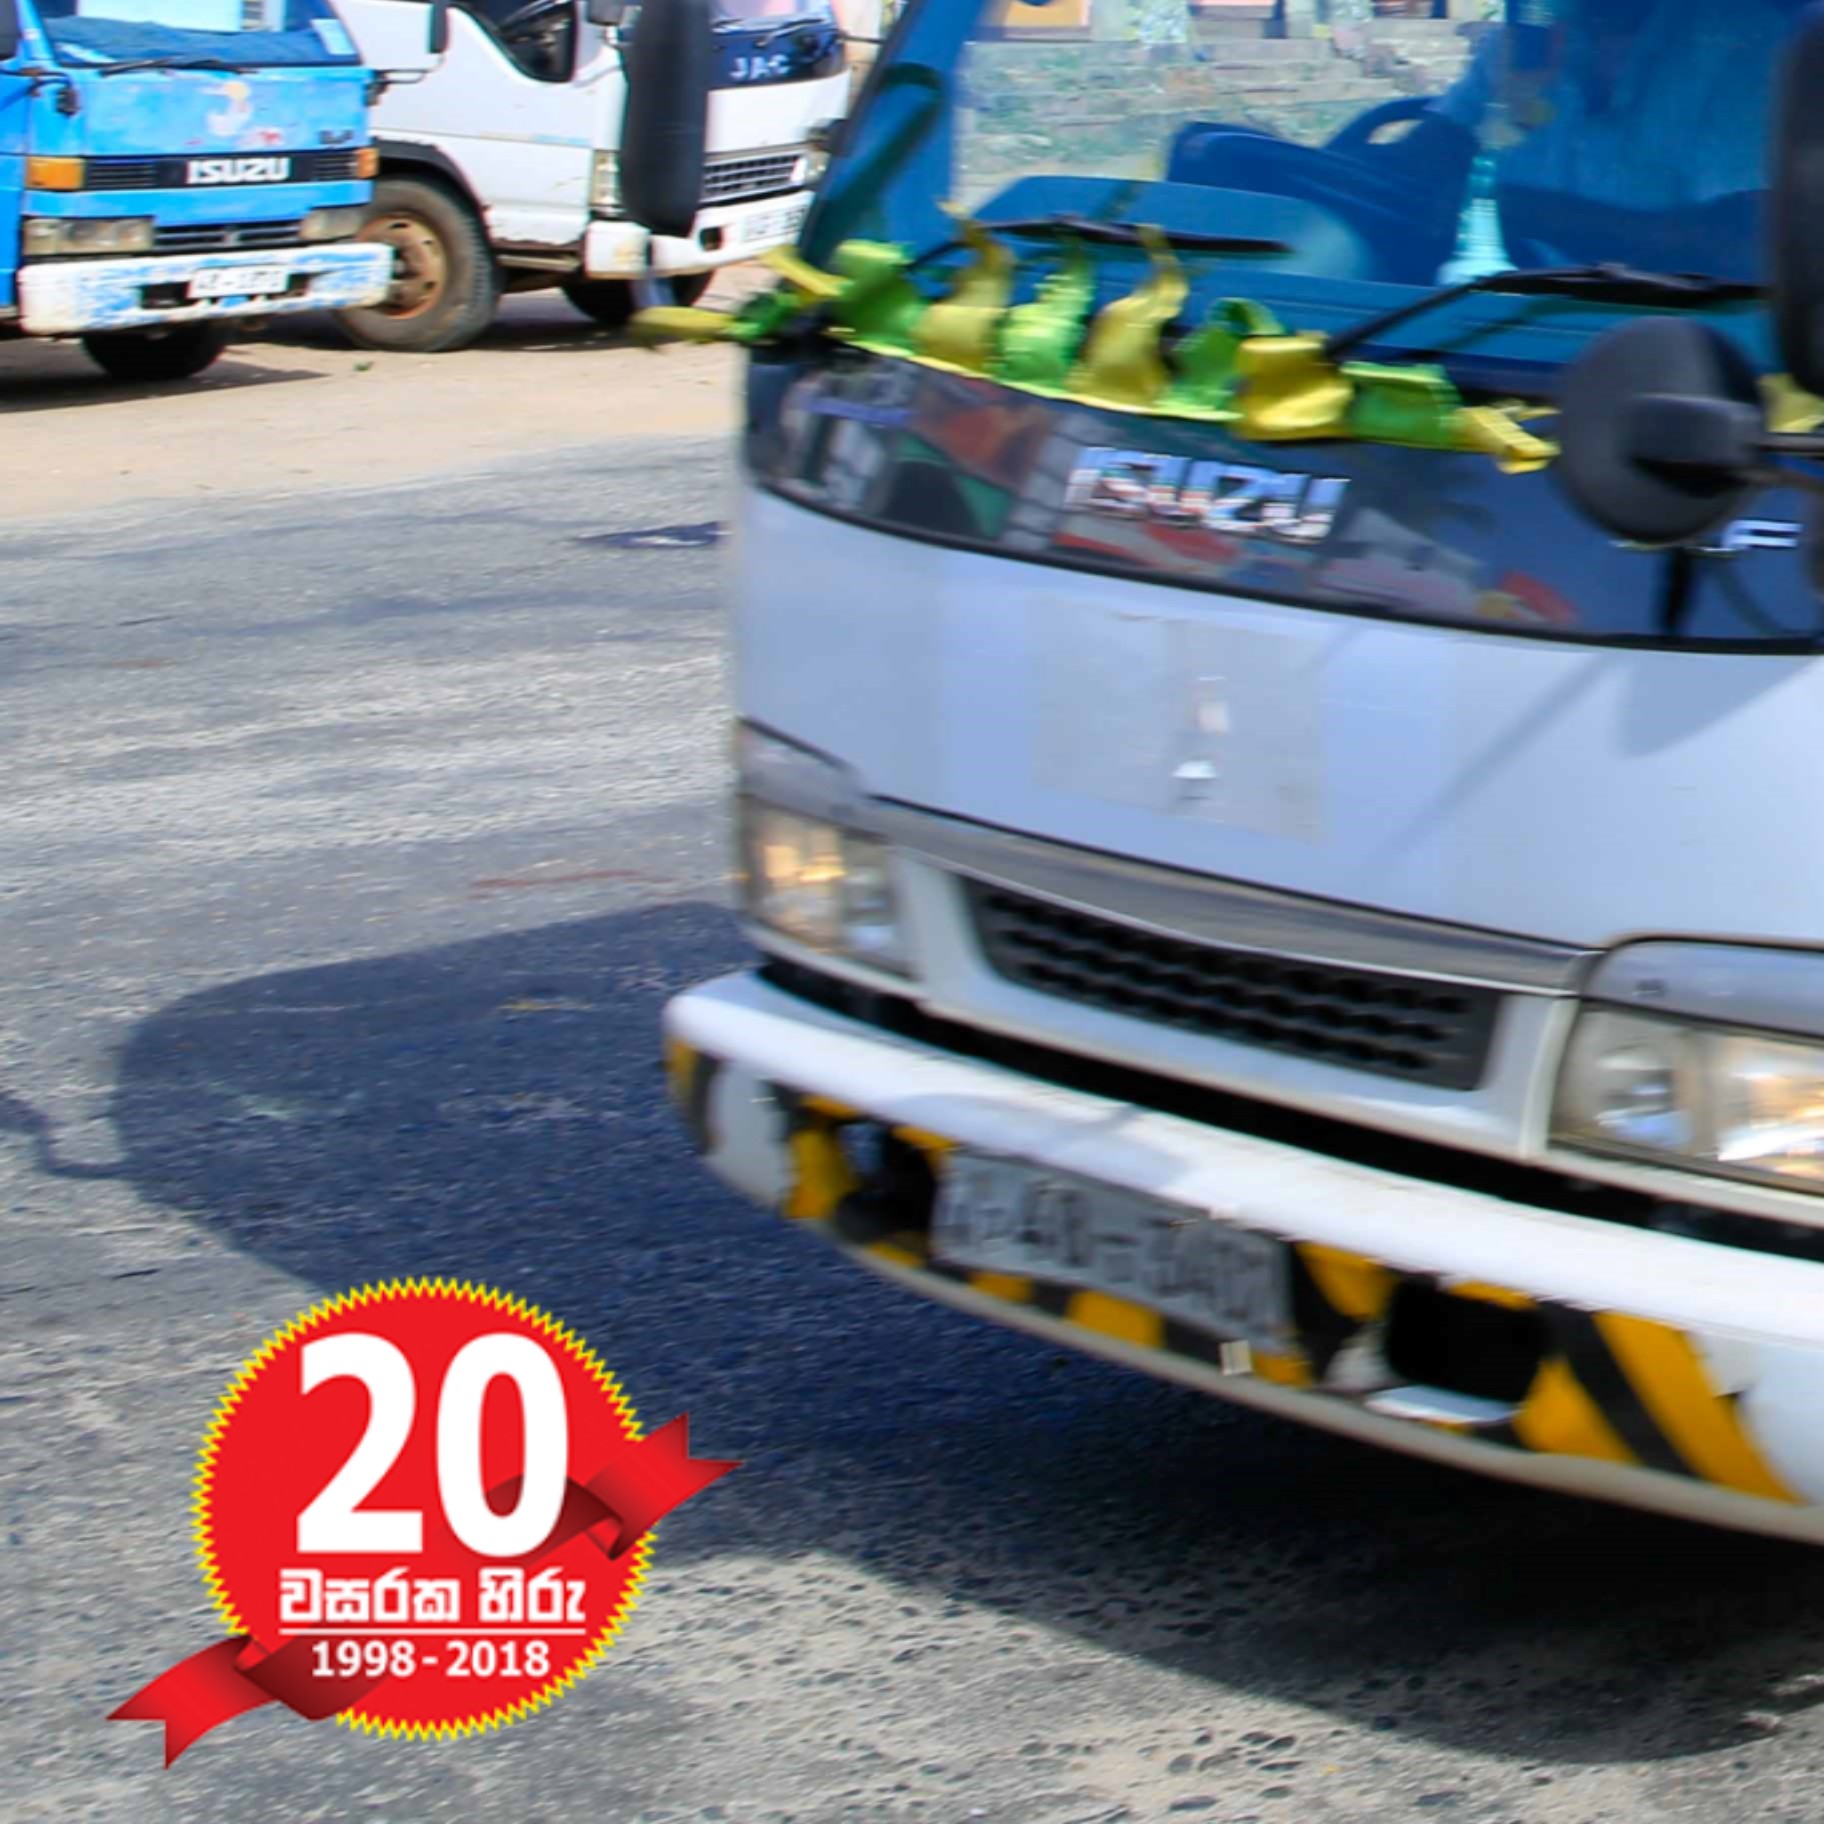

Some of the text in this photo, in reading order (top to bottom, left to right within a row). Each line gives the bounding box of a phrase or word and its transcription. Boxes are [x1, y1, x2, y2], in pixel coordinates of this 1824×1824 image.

[729, 53, 790, 81] JAC
[186, 157, 291, 184] ISUZU
[1064, 446, 1351, 543] ISUZU
